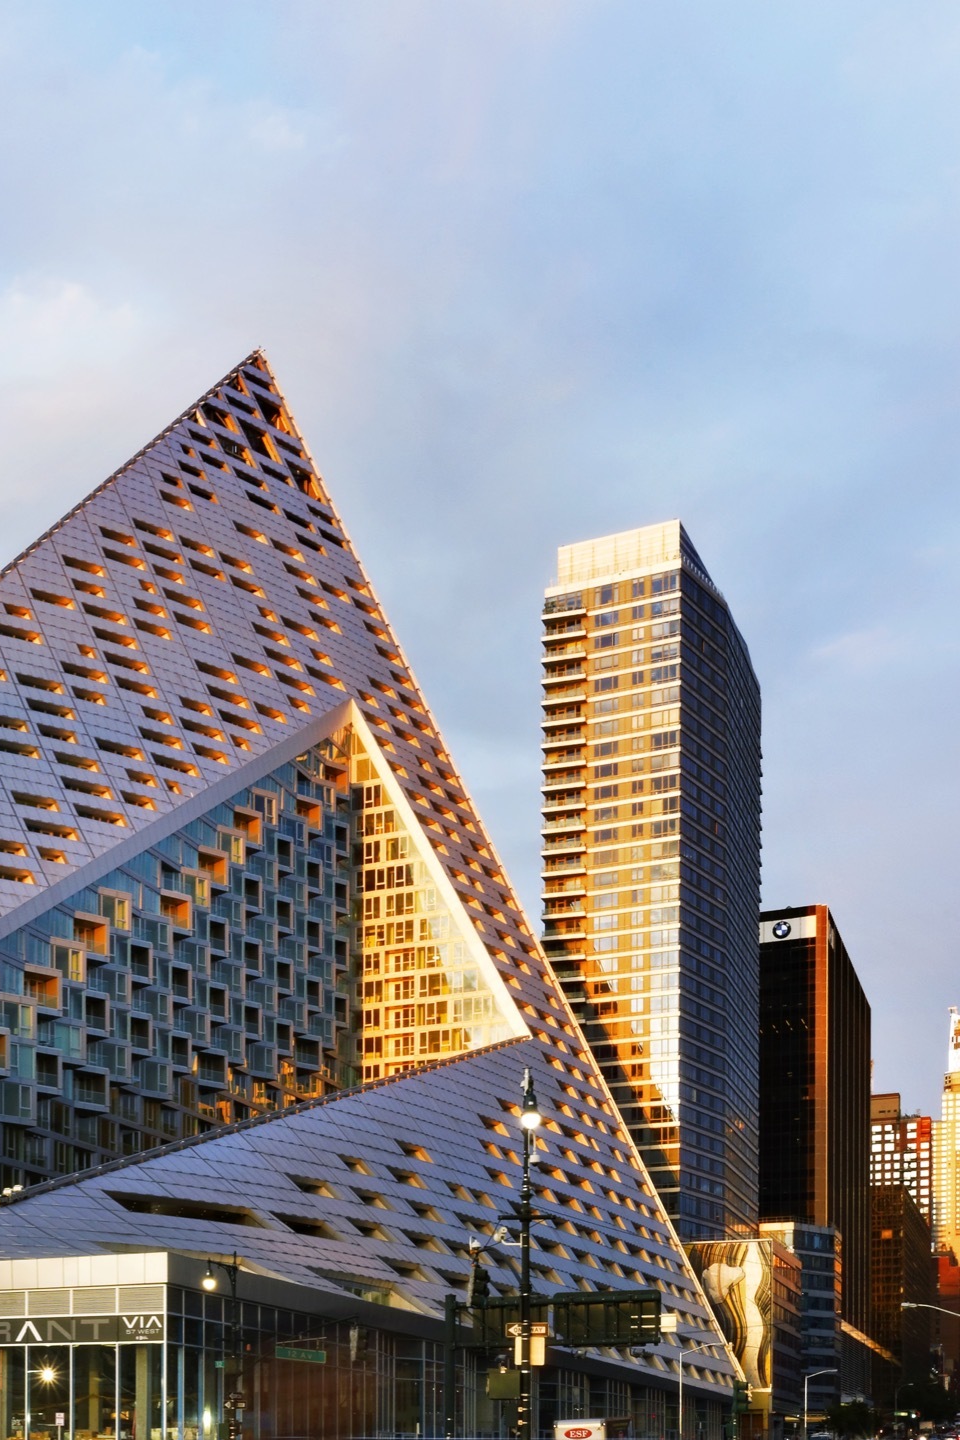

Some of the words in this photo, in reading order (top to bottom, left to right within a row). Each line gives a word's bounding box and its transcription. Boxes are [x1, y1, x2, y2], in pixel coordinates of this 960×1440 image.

[122, 1315, 162, 1328] VIA
[288, 1350, 297, 1358] 12
[569, 1430, 588, 1438] ESF
